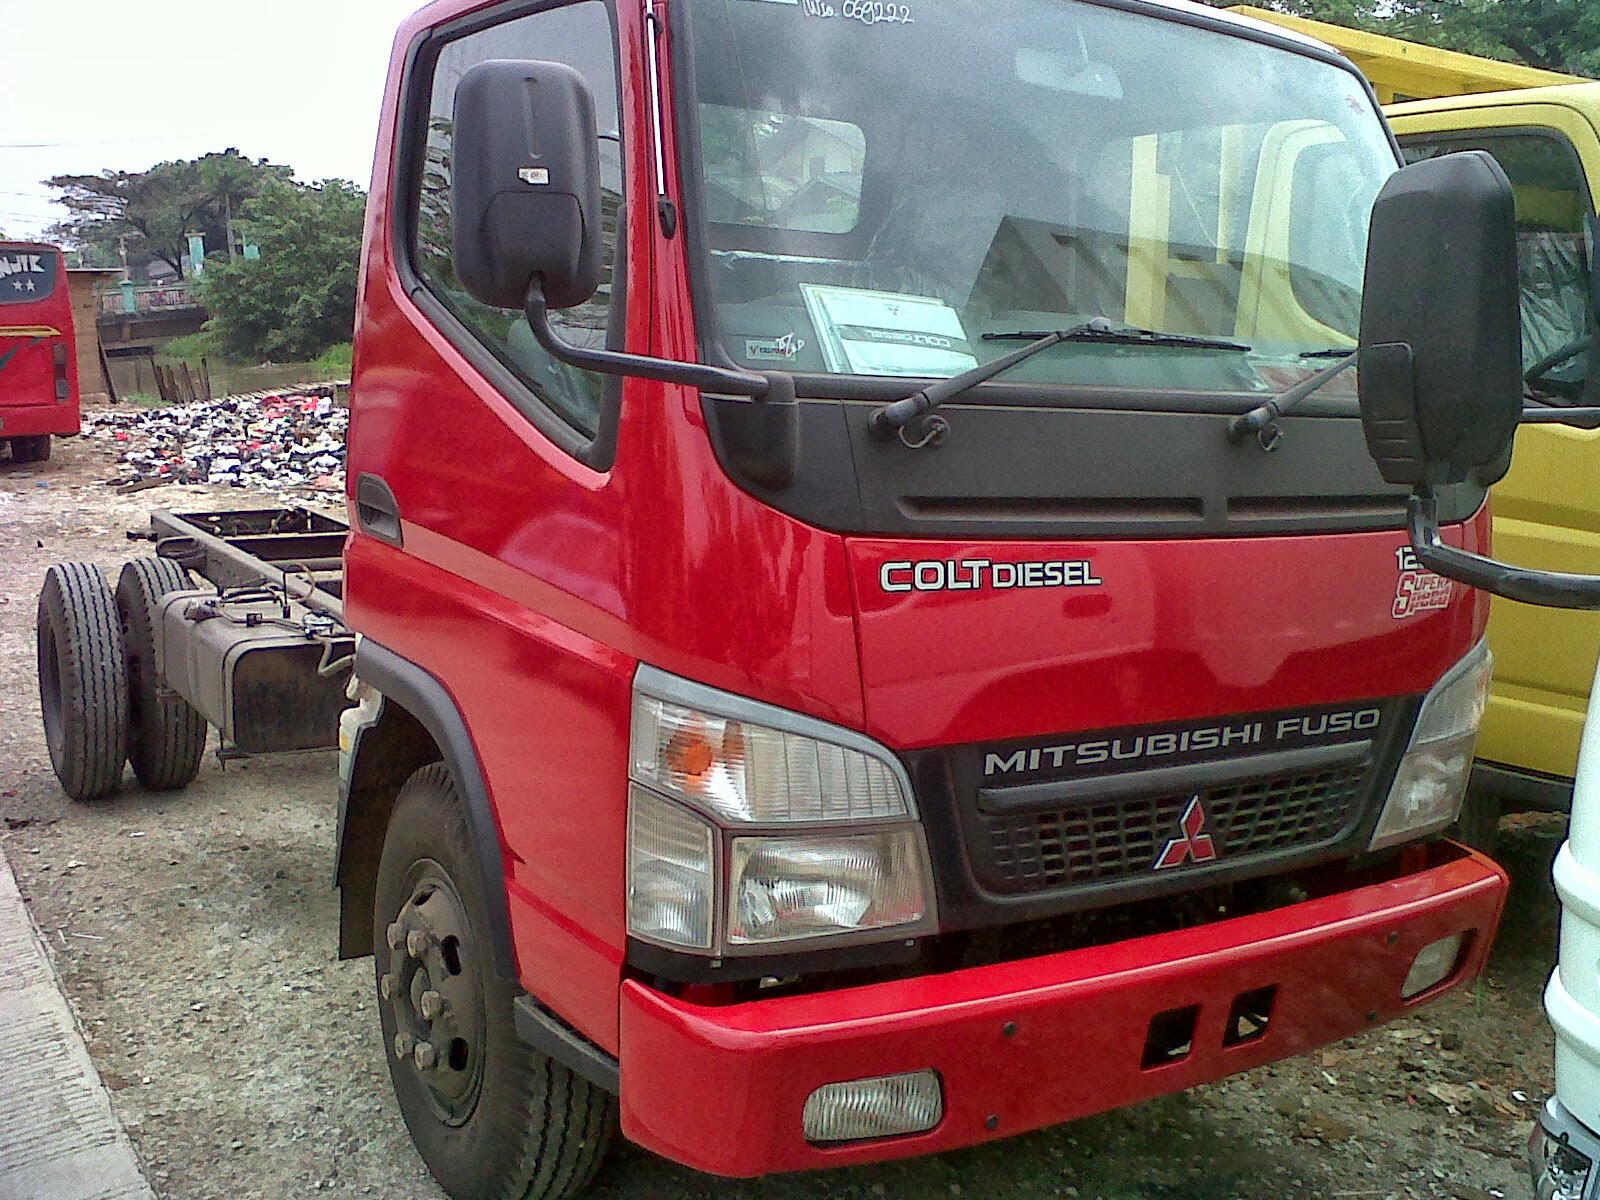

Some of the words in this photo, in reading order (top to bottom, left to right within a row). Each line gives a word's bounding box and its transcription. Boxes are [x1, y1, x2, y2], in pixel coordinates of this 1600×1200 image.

[880, 559, 990, 592] COLT
[992, 561, 1102, 588] DIESEL
[984, 722, 1262, 775] MITSUBISHI
[1276, 708, 1381, 740] FUSO
